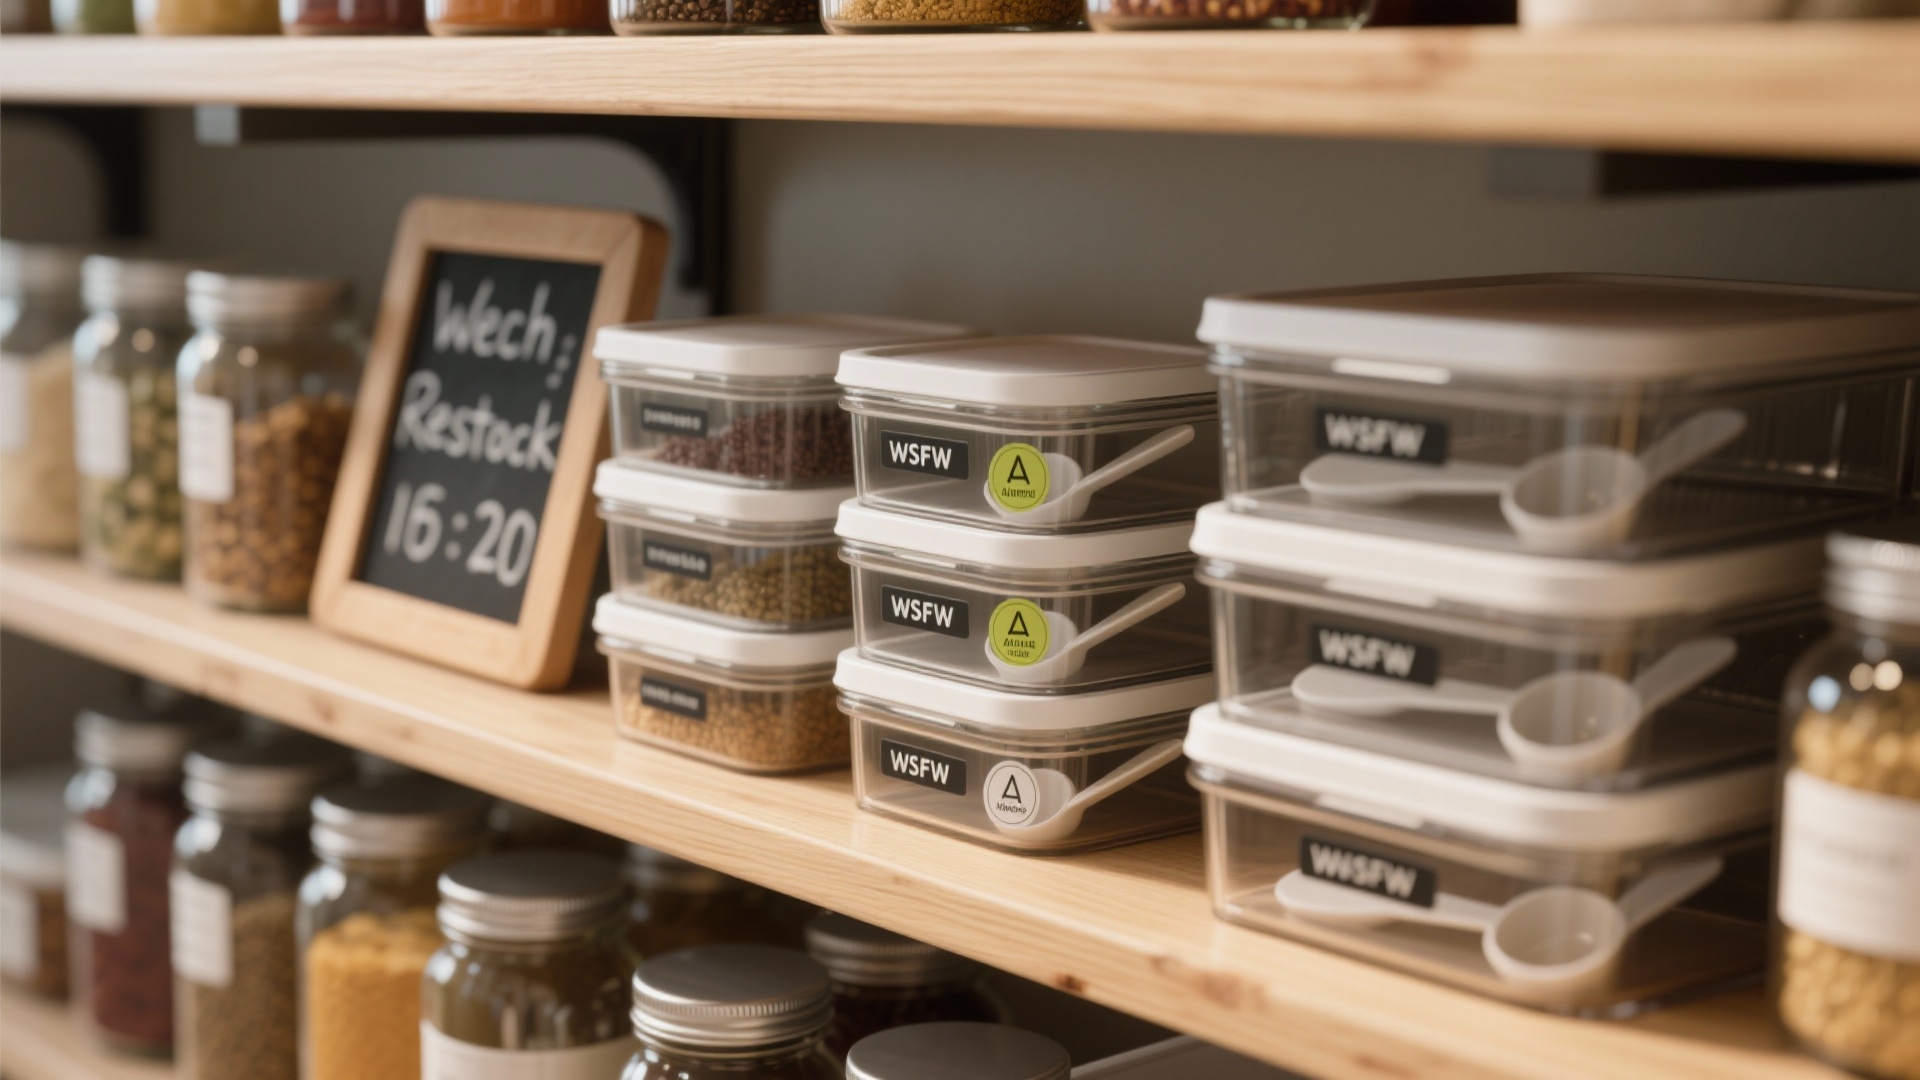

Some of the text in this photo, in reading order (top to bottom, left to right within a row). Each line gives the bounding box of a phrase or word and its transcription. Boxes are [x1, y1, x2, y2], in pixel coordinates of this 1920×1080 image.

[394, 369, 562, 472] Restock
[1324, 412, 1426, 458] WSFW
[889, 440, 952, 470] WSFW
[1007, 454, 1030, 485] A
[383, 481, 537, 587] 16:20
[891, 594, 954, 629] WSFW
[1319, 629, 1416, 677] WSFW
[890, 749, 950, 785] WSFW
[1002, 774, 1022, 804] A
